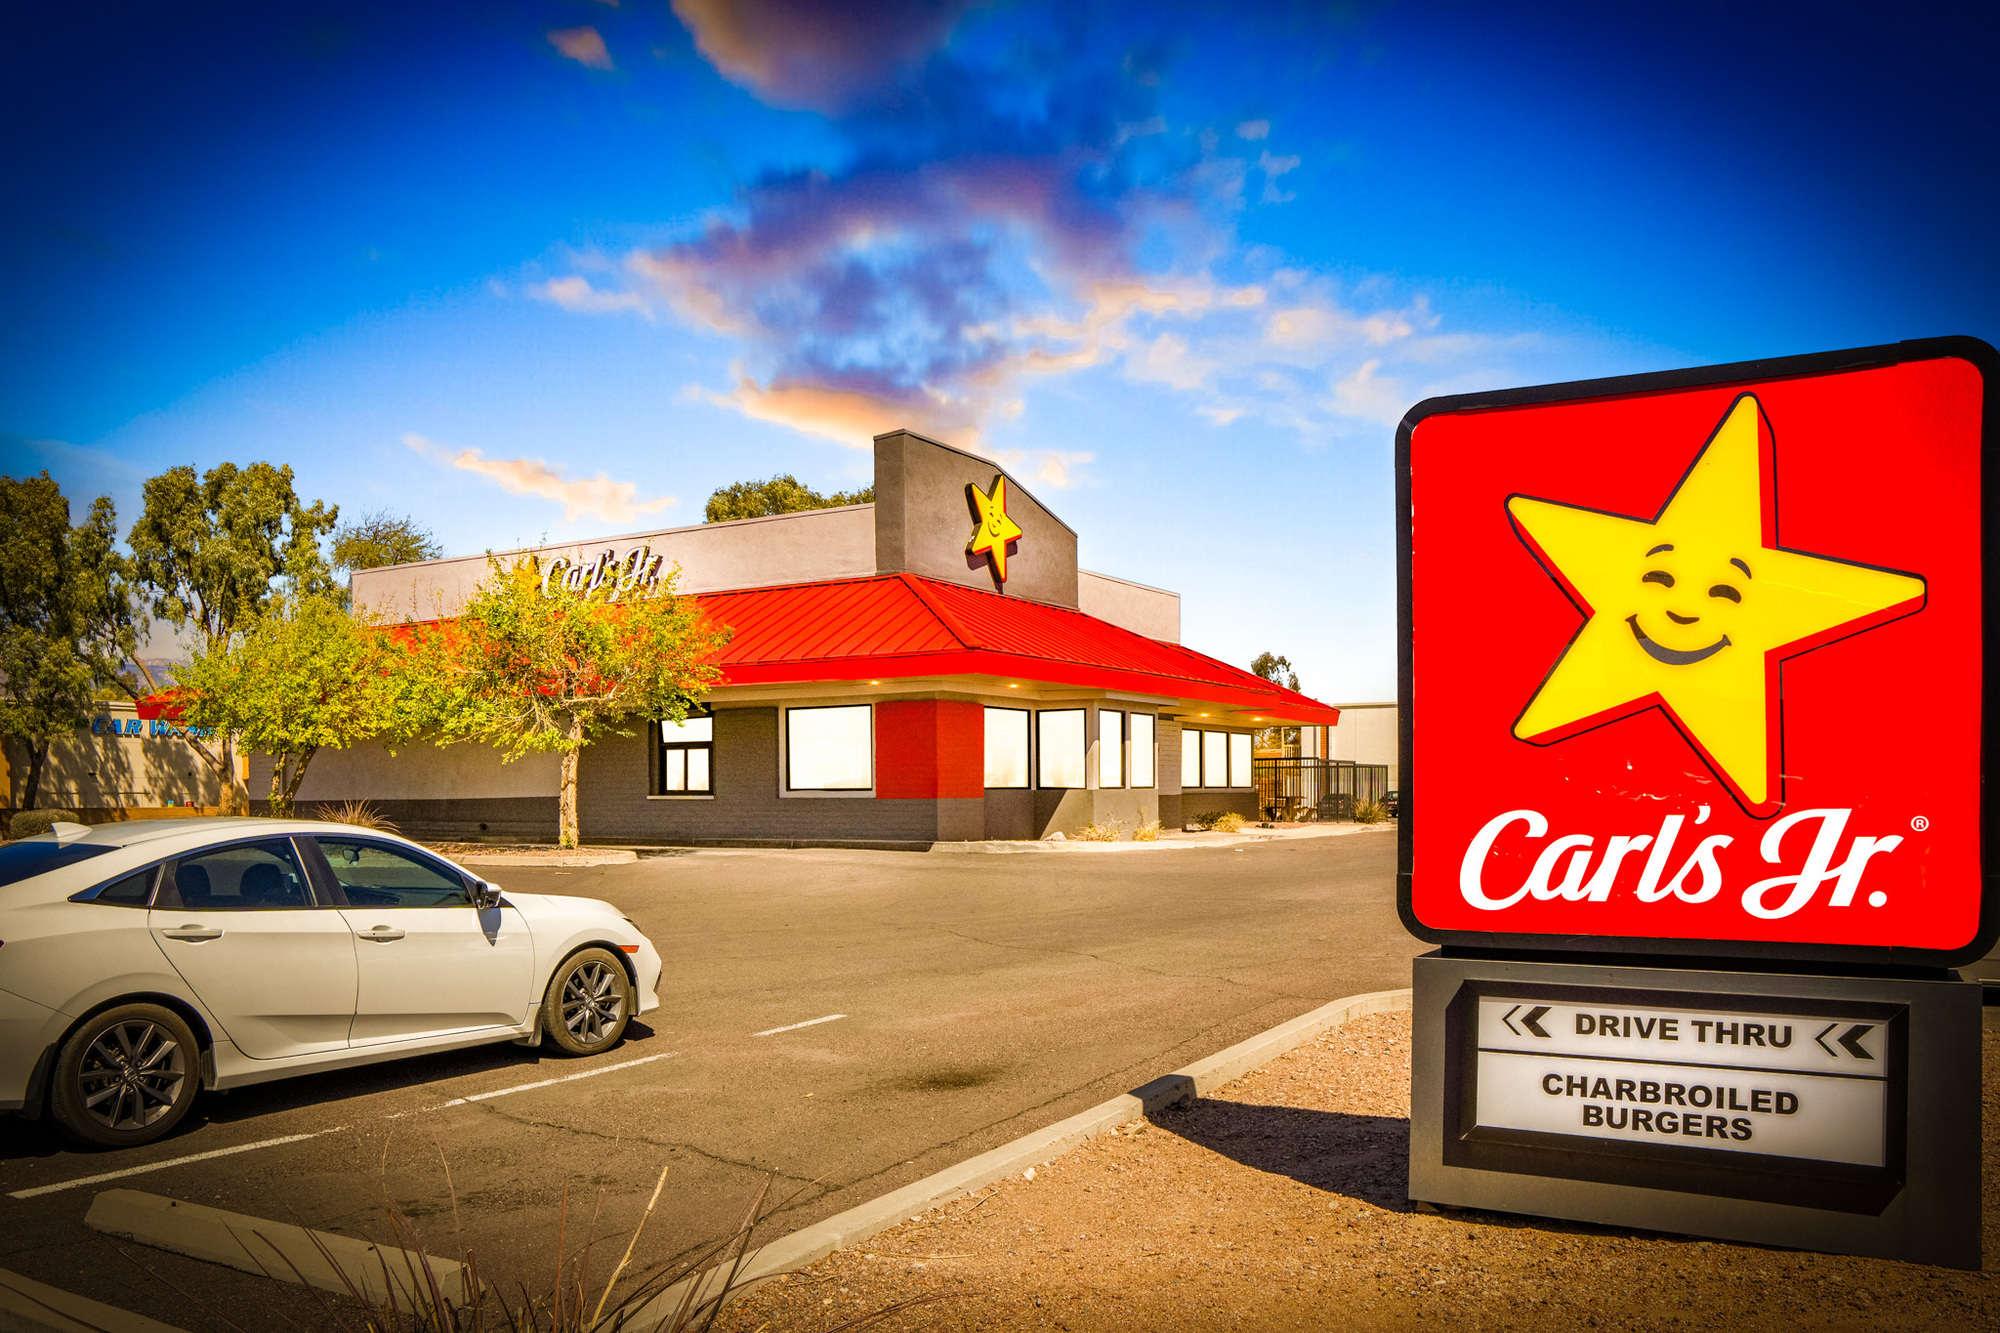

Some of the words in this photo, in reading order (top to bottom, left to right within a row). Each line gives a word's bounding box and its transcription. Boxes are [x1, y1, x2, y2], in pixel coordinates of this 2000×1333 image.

[617, 546, 662, 593] Jr.
[92, 718, 142, 735] CAR
[1460, 805, 1734, 911] Carl's
[1742, 808, 1905, 920] Jr.
[1575, 1013, 1679, 1041] DRIVE
[1691, 1020, 1793, 1048] THRU
[1542, 1073, 1799, 1115] CHARBROILED
[1582, 1104, 1753, 1141] BURGERS
